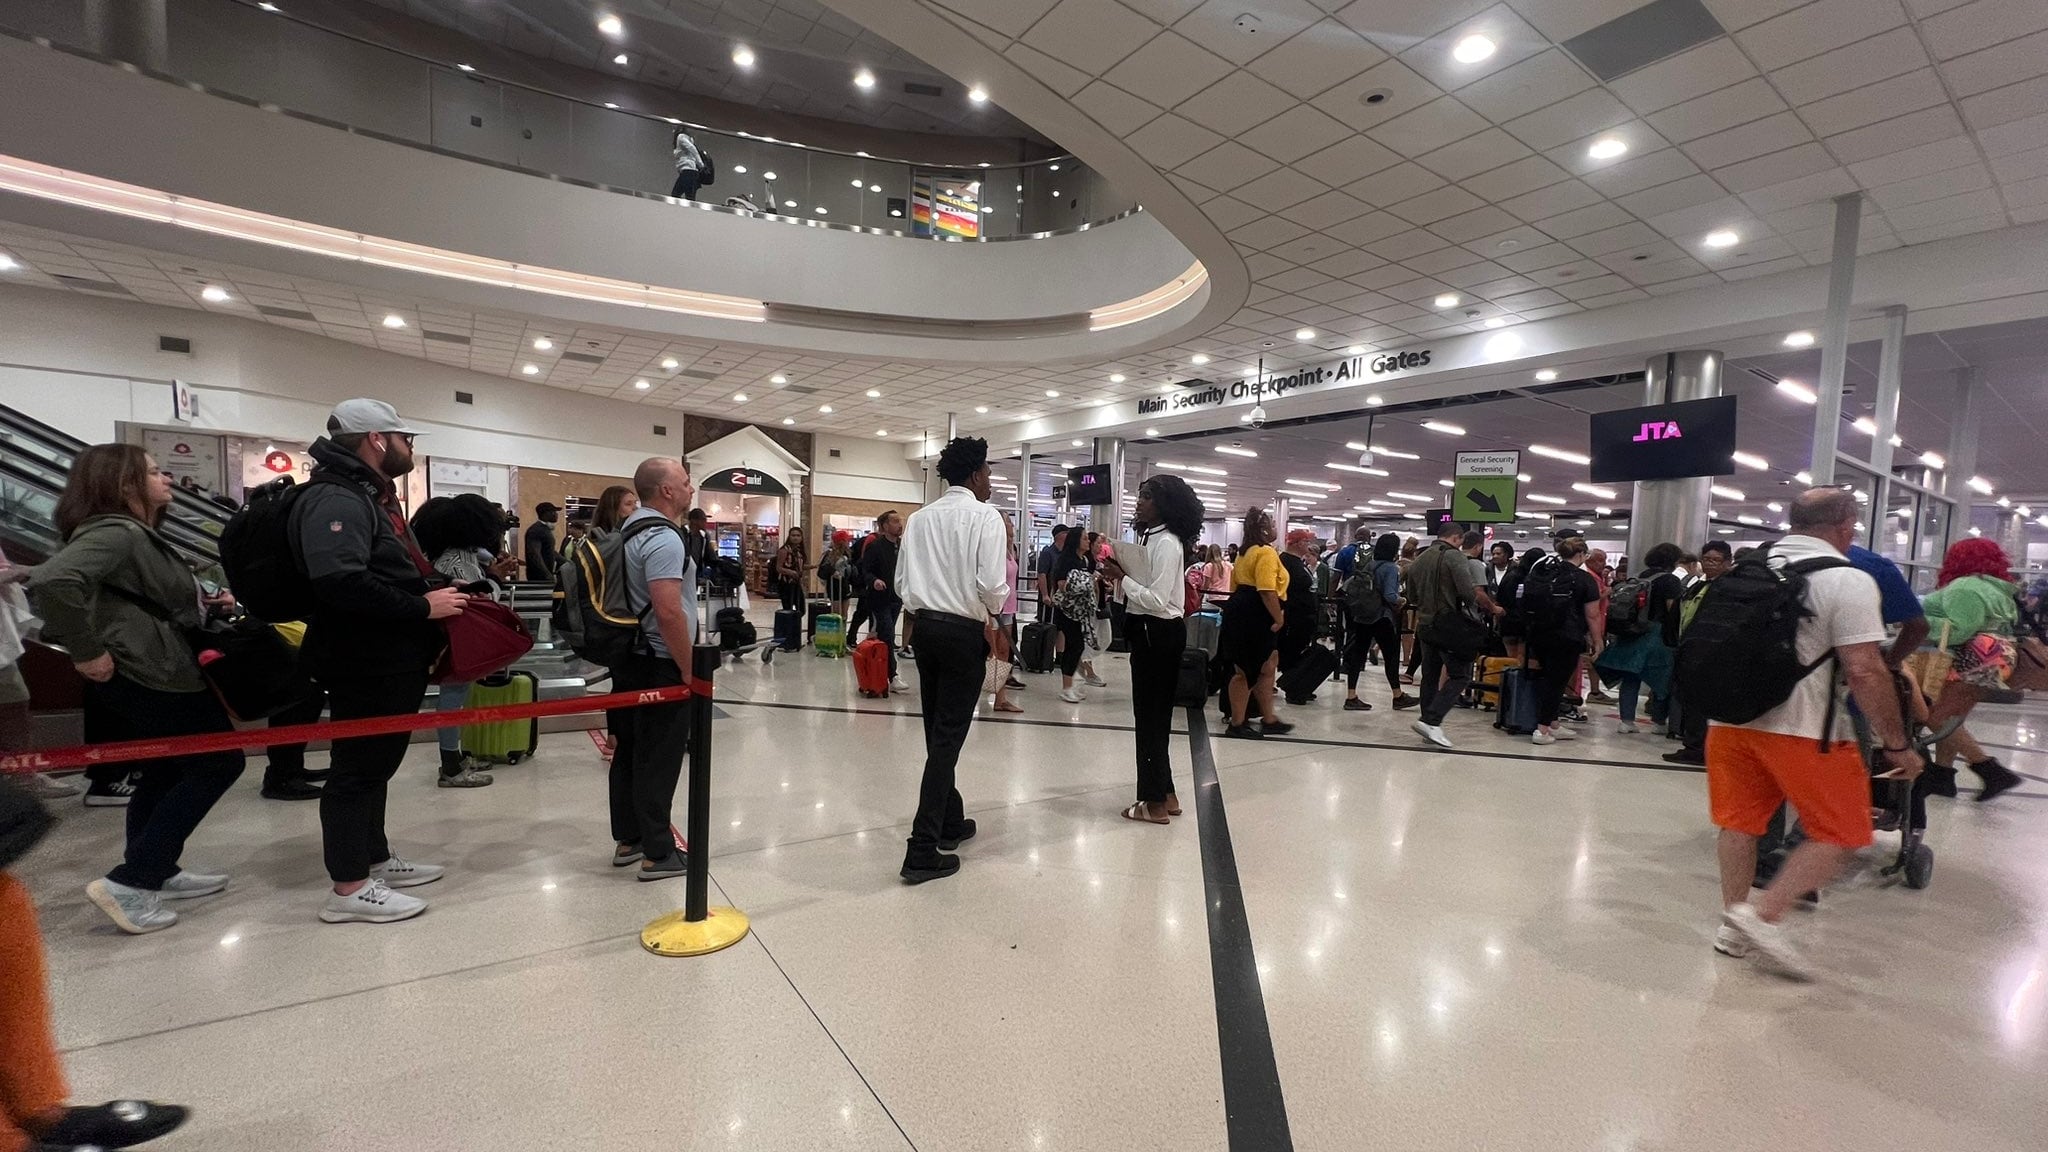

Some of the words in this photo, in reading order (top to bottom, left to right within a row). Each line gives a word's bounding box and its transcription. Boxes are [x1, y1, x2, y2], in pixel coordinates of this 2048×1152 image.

[1138, 397, 1168, 414] Main
[1173, 386, 1227, 410] Security
[1231, 367, 1324, 398] Checkpoint
[1335, 357, 1363, 382] All
[1371, 350, 1431, 374] Gates
[1460, 456, 1486, 464] General
[1487, 456, 1516, 465] Security
[1470, 466, 1504, 474] Screening
[638, 690, 666, 704] ATL
[0, 753, 50, 770] ATL
